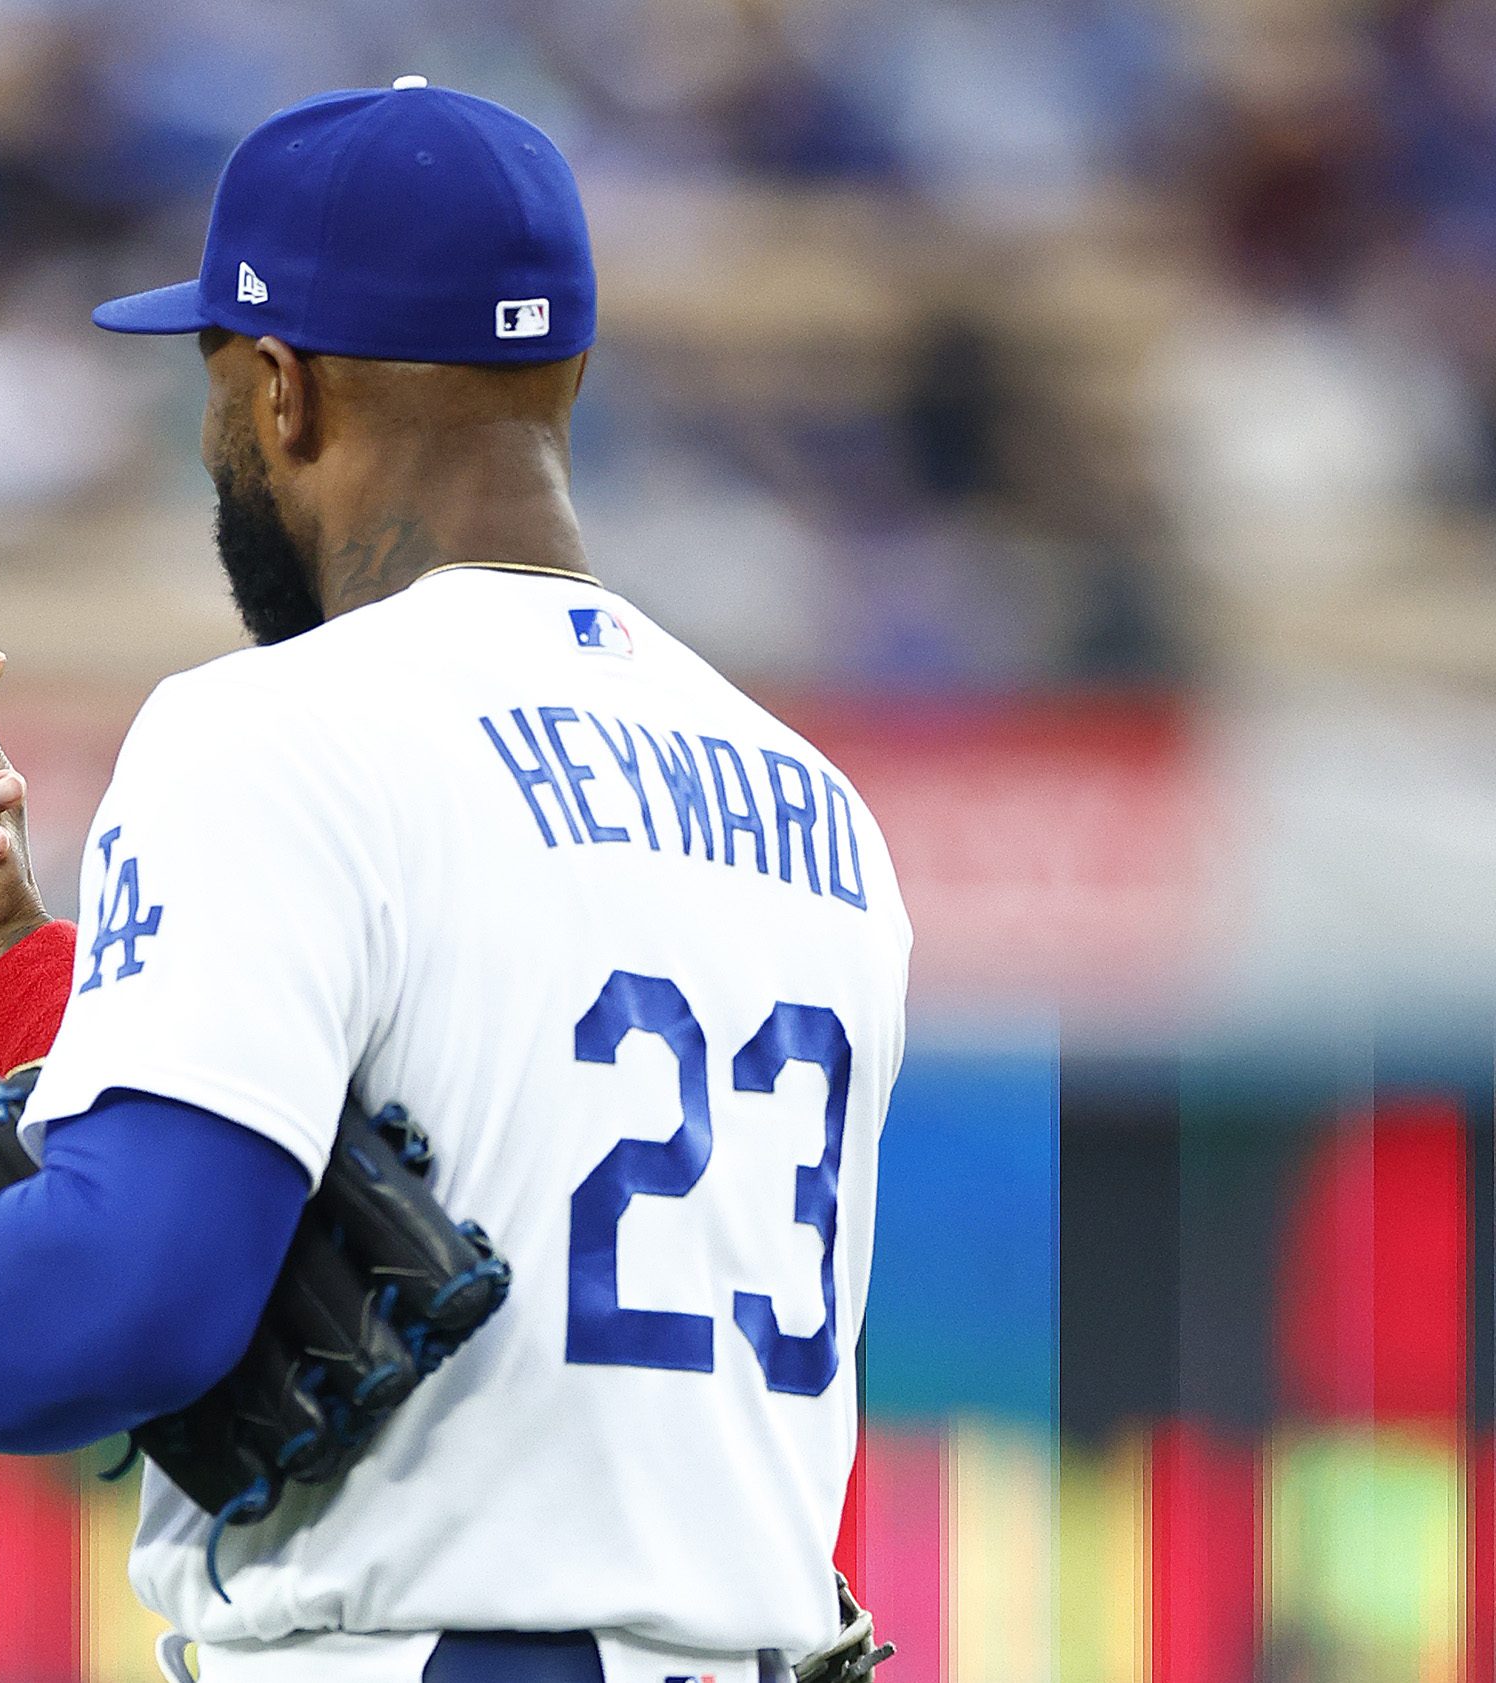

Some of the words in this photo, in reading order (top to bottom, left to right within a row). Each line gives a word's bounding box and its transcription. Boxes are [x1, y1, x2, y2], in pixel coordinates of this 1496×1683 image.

[78, 825, 164, 995] LA
[479, 705, 868, 912] HEYWARD
[565, 969, 853, 1397] 23
